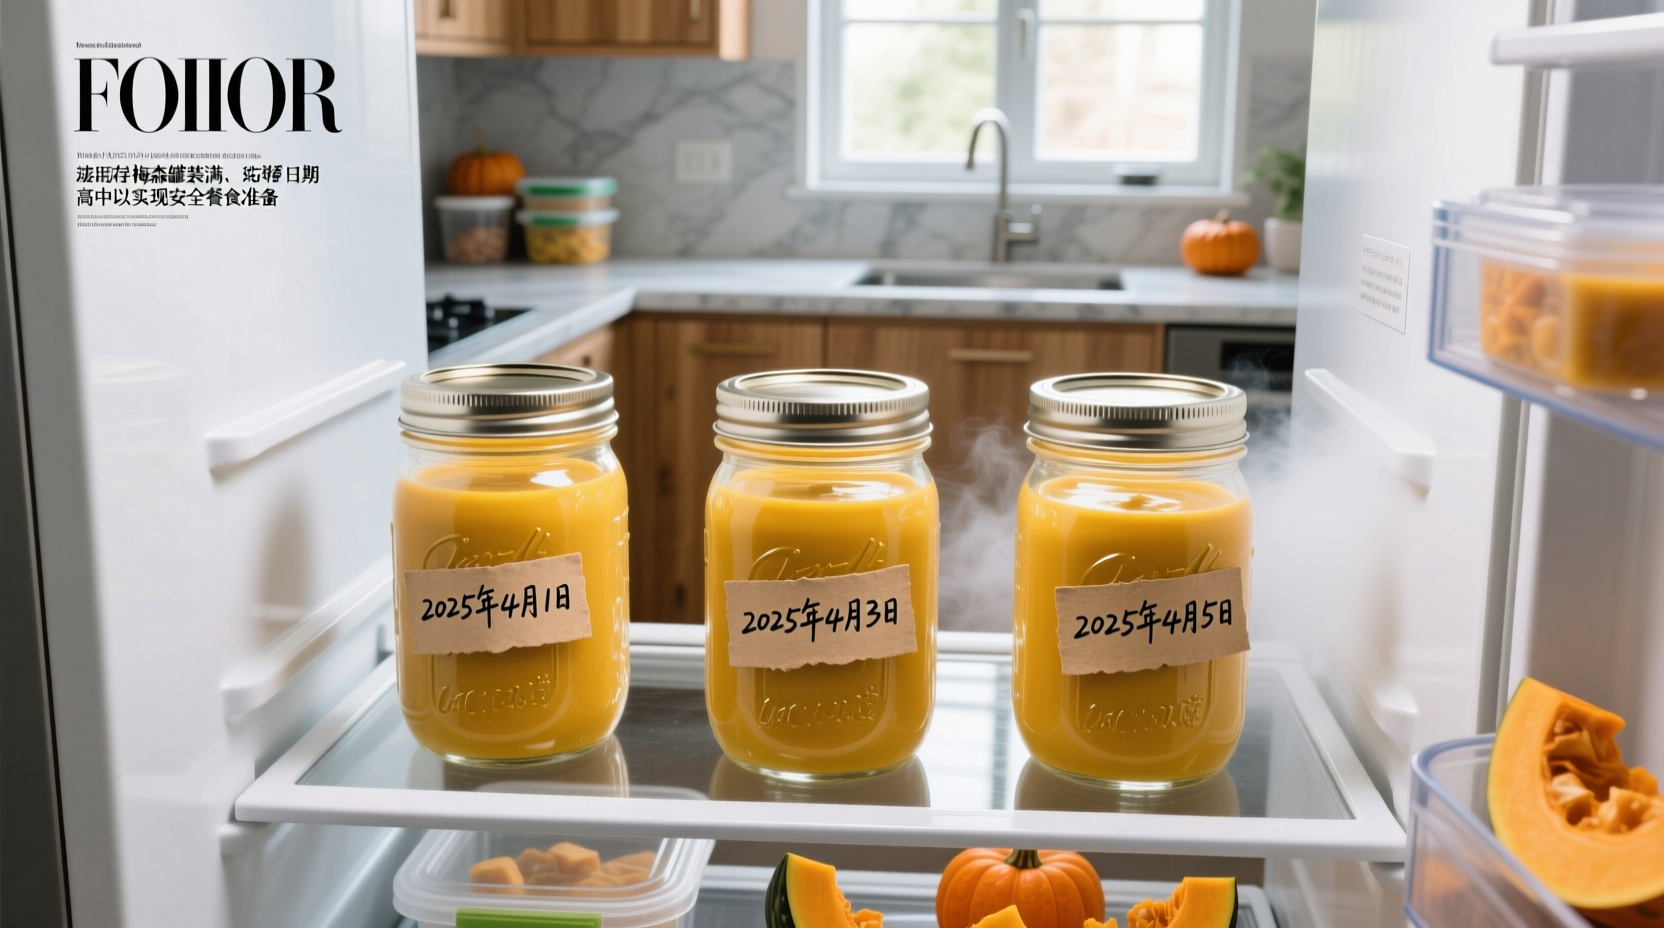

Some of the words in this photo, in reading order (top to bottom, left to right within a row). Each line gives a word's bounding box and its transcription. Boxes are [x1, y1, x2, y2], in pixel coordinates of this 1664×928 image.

[421, 583, 571, 629] 2025年4月1日
[741, 597, 898, 643] 2025年4月3日
[1073, 598, 1233, 644] 2025年4月5日
